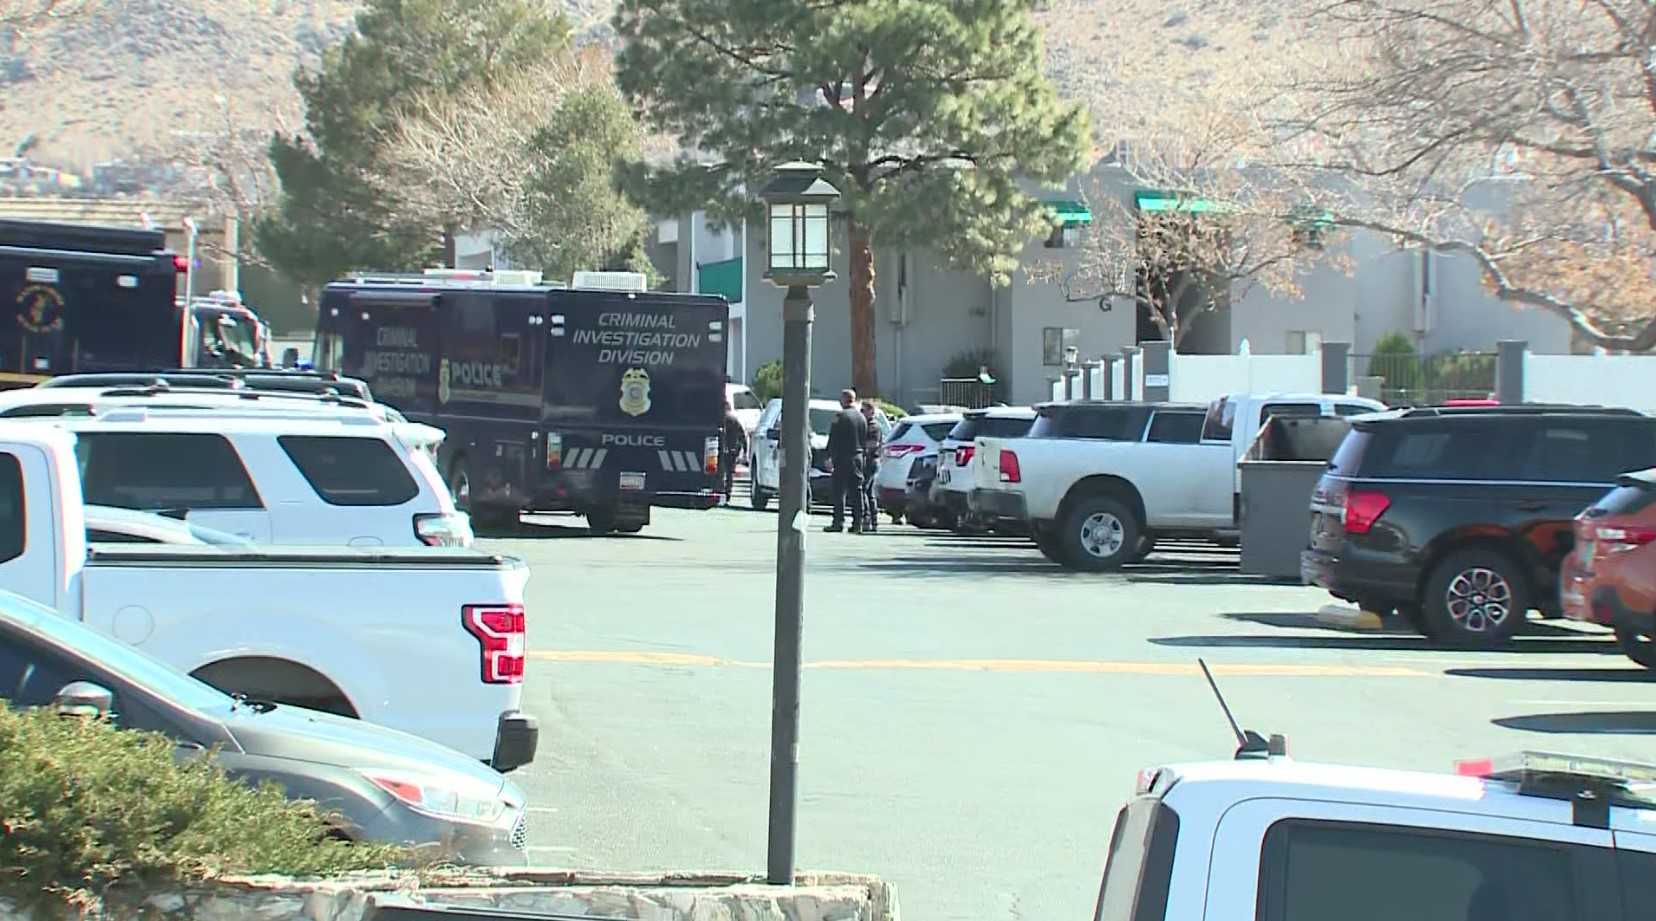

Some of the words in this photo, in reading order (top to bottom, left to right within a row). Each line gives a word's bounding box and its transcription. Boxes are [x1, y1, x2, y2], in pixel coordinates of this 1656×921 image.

[598, 312, 677, 329] CRIMINAL
[572, 329, 701, 348] INVESTIGATION
[597, 348, 675, 365] DIVISION
[452, 361, 502, 386] POLICE
[602, 434, 665, 447] POLICE
